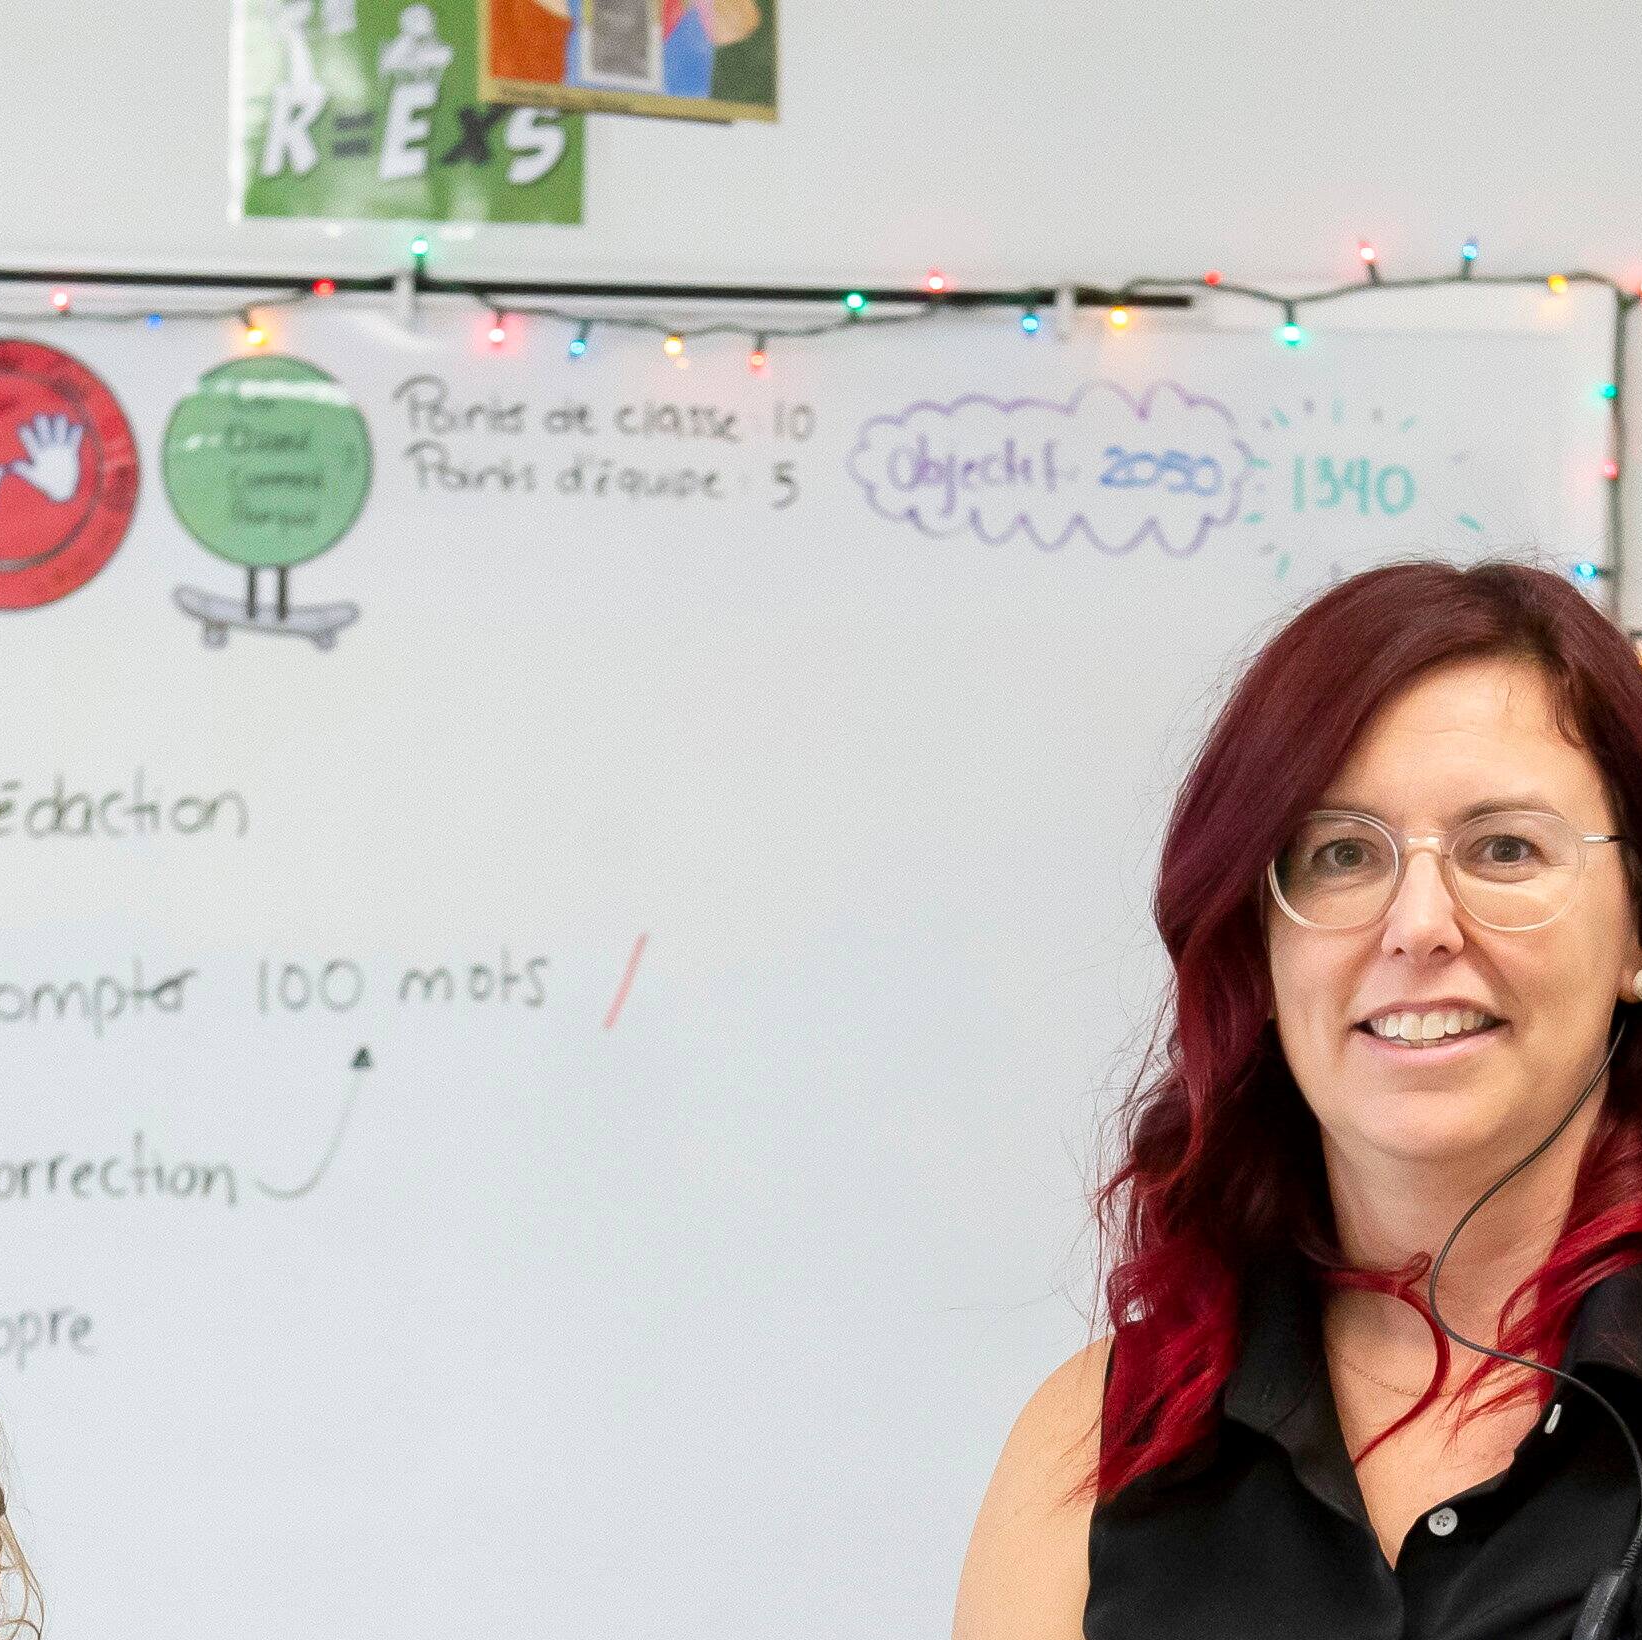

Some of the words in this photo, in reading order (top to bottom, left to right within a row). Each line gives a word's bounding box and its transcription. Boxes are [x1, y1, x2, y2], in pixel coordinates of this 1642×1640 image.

[542, 393, 597, 437] de
[773, 399, 817, 444] 10
[401, 438, 538, 494] Points
[771, 460, 800, 511] 5
[1292, 455, 1416, 517] 1340
[254, 954, 365, 1015] 100
[397, 945, 550, 1010] mots
